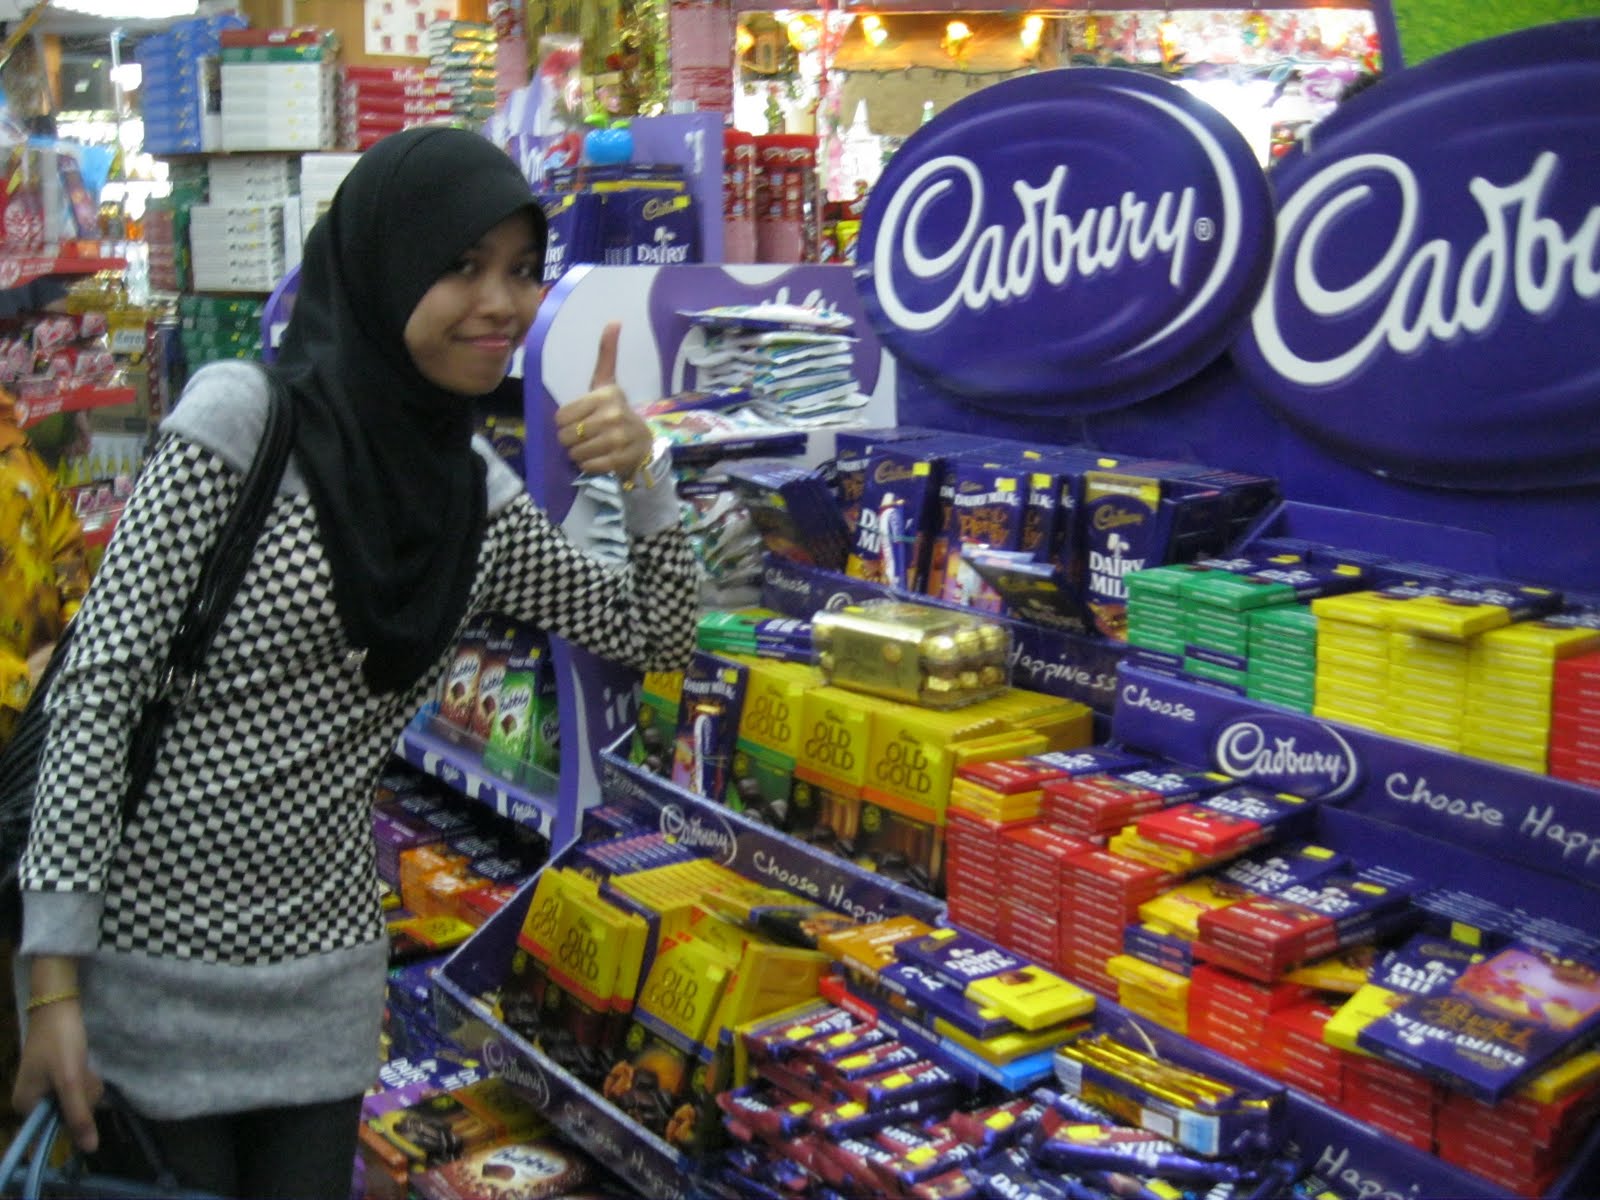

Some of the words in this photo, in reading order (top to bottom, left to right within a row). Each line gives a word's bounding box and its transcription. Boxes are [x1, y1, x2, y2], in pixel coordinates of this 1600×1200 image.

[637, 244, 690, 263] DAIRY
[874, 155, 1195, 331] Cadbury
[1090, 551, 1146, 577] DAIRY
[1089, 574, 1130, 598] MIL
[755, 696, 790, 722] OLD
[745, 711, 791, 743] GOLD
[814, 720, 852, 749] OLD
[804, 738, 855, 771] GOLD
[885, 741, 929, 771] OLD
[1122, 684, 1196, 722] Choose
[1216, 721, 1345, 784] Cadbury
[1385, 771, 1504, 827] Choose
[875, 760, 932, 794] GOLD
[753, 850, 820, 899] Choose
[567, 927, 599, 958] OLD
[560, 941, 600, 981] GOLD
[662, 967, 698, 999] OLD
